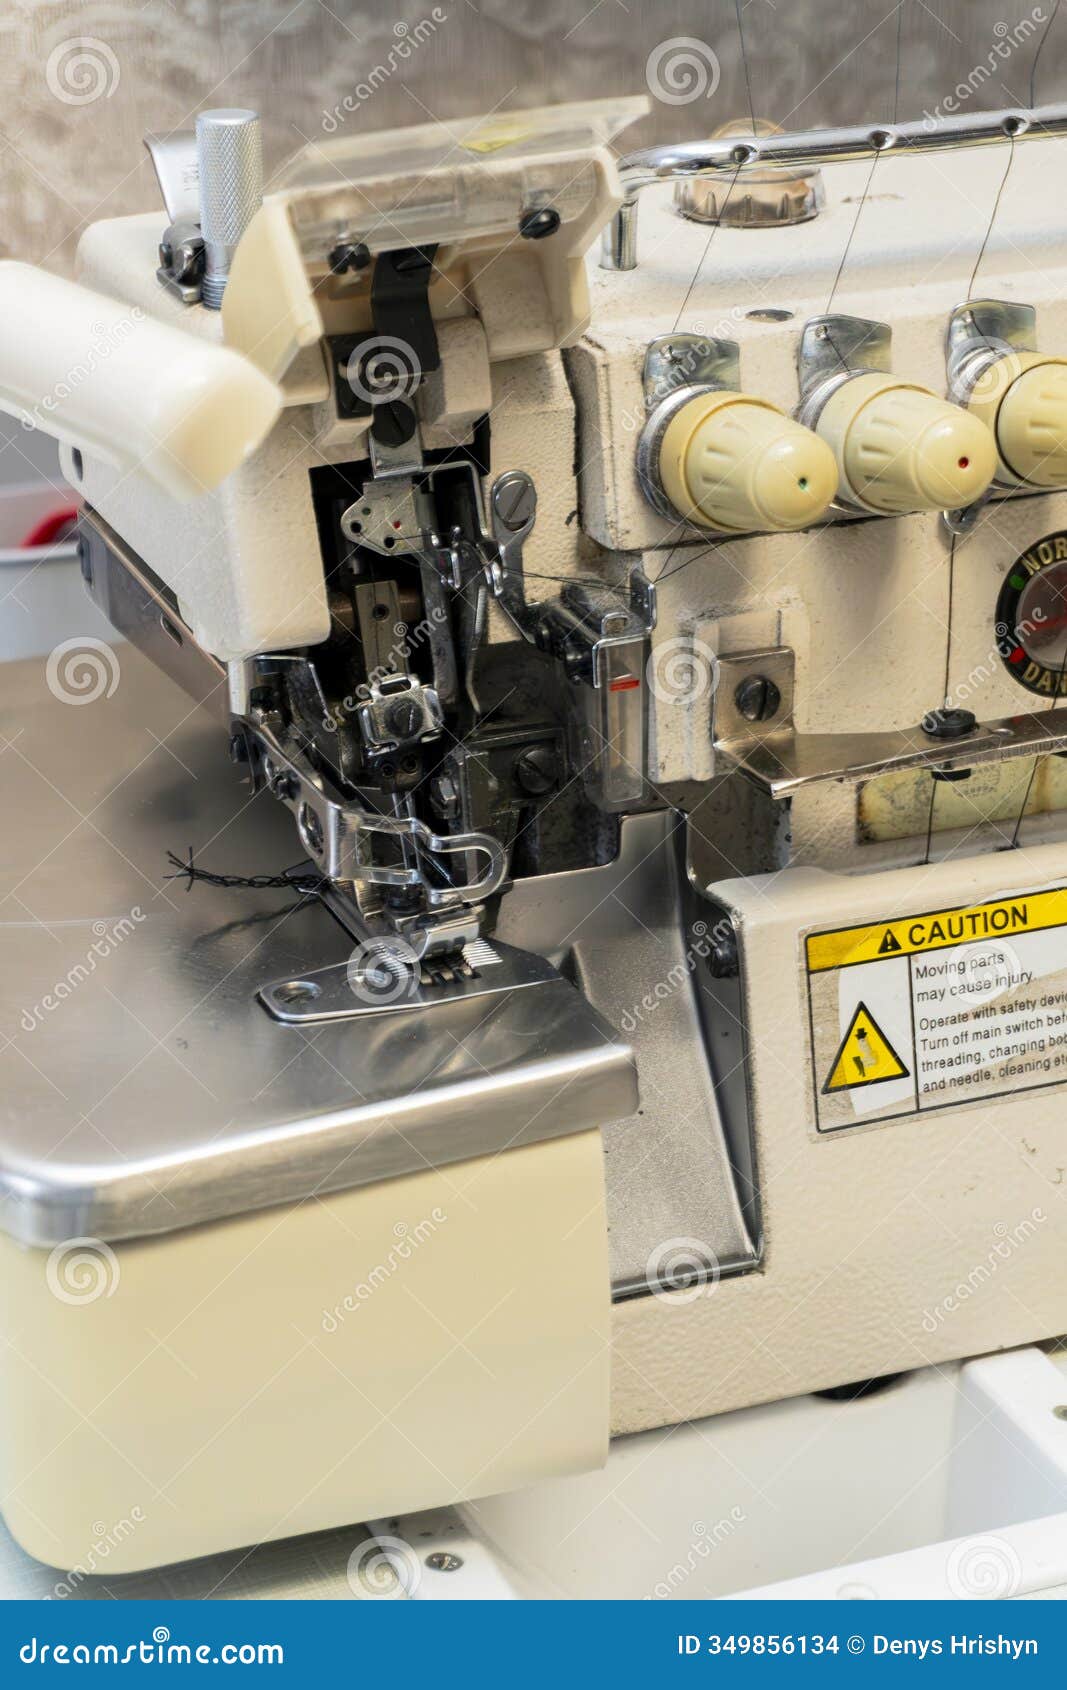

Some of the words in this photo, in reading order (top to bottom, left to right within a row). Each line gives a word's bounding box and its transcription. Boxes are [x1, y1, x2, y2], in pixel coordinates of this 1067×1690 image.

[908, 904, 1028, 946] CAUTION
[915, 960, 966, 980] Moving
[970, 953, 1005, 971] parts
[917, 987, 946, 1003] may
[950, 979, 992, 997] cause
[920, 1011, 969, 1031] Operate
[972, 1006, 997, 1020] with
[1000, 998, 1037, 1015] safety
[920, 1037, 949, 1051] Turn
[952, 1030, 969, 1045] off
[972, 1026, 1001, 1041] main
[1005, 1017, 1044, 1035] switch
[921, 1051, 985, 1073] threading,
[989, 1039, 1045, 1059] changing
[923, 1079, 946, 1093] and
[949, 1069, 996, 1087] needle,
[998, 1057, 1050, 1077] cleaning
